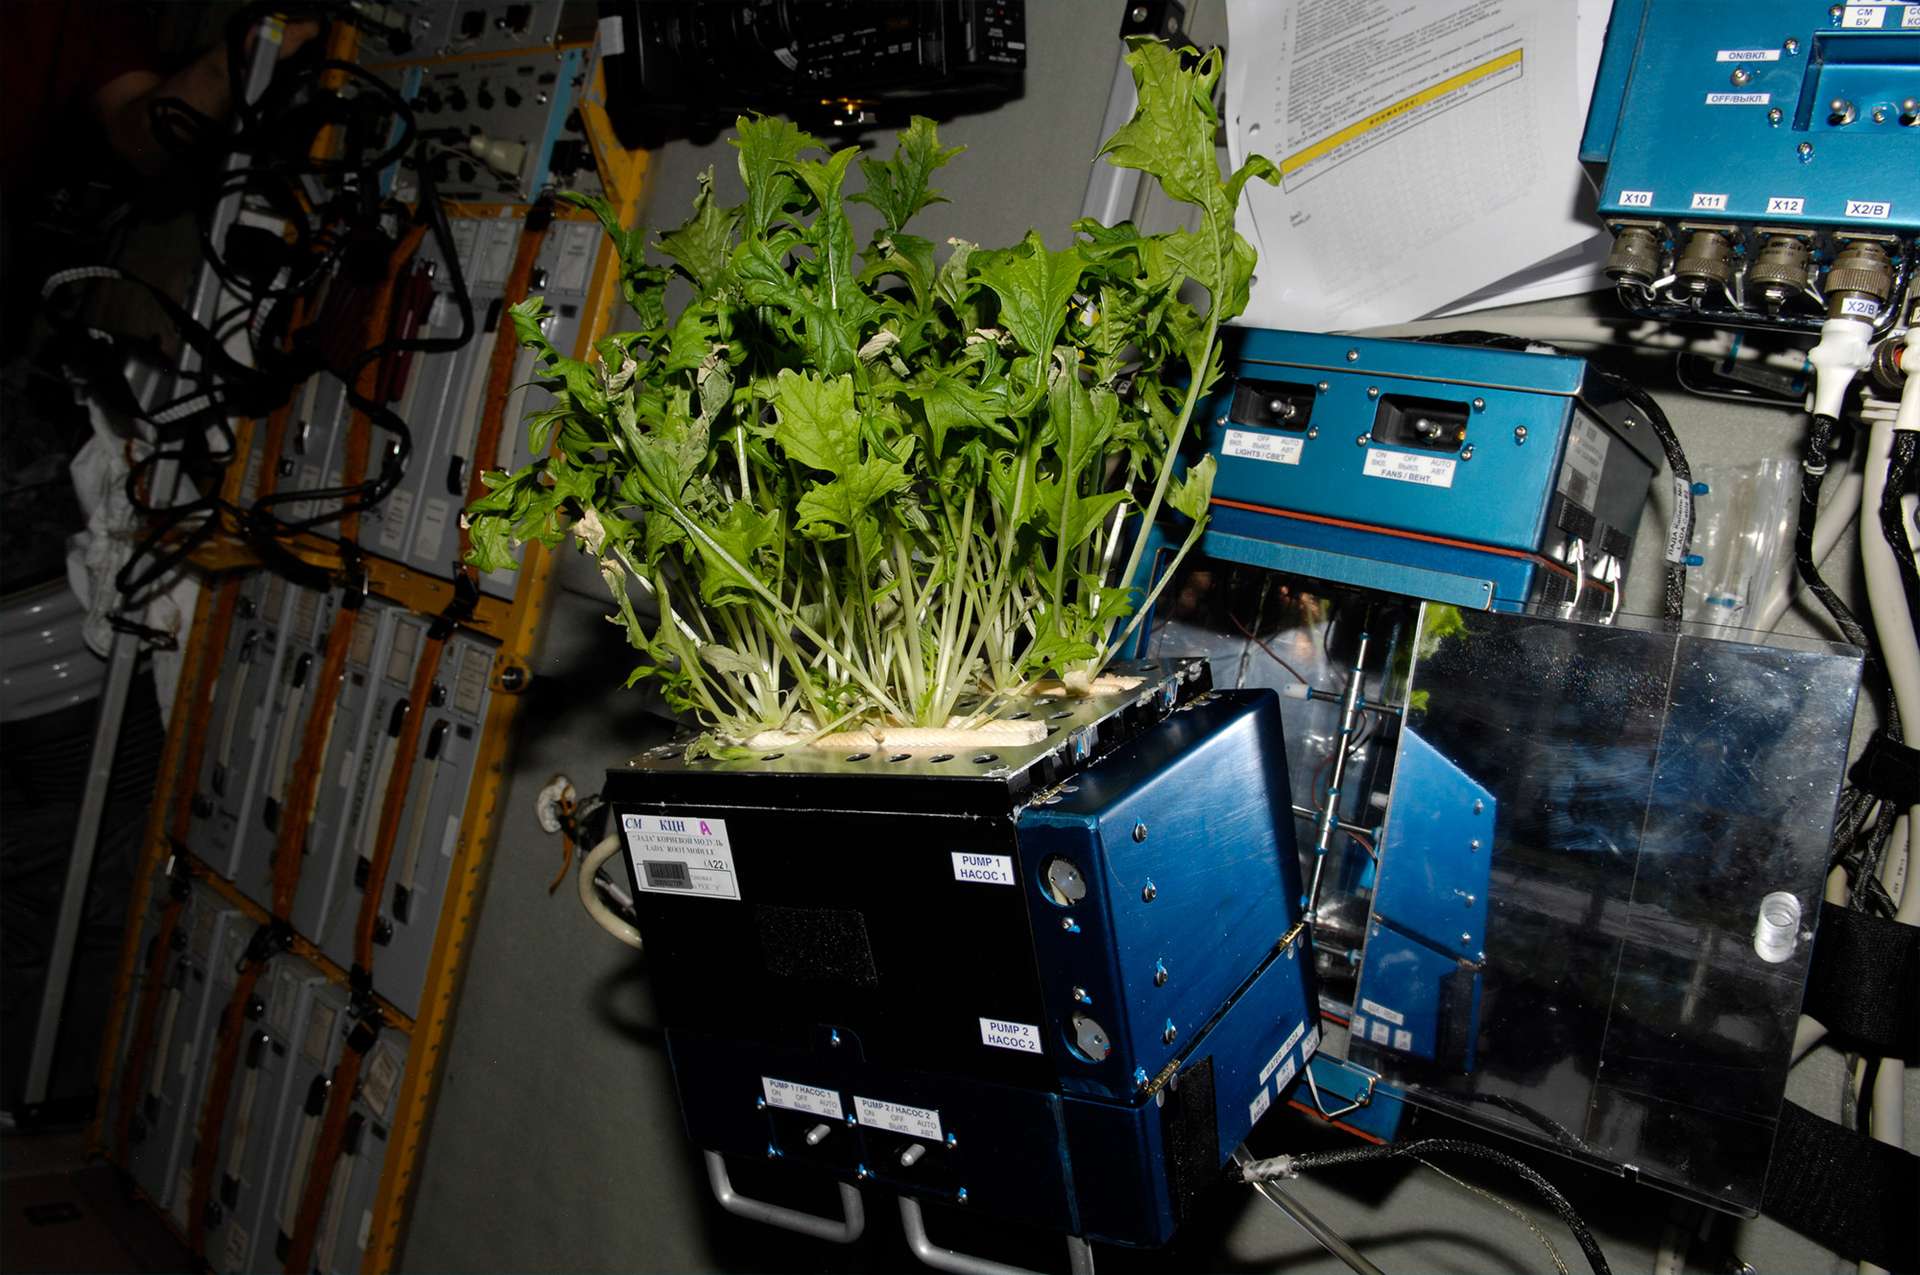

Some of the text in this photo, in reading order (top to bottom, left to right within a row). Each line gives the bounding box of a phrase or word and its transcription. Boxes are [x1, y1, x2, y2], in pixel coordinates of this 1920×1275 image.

[1624, 193, 1648, 204] X10
[1697, 197, 1721, 207] X11
[1772, 200, 1799, 211] X12
[1380, 468, 1403, 479] FANS
[962, 855, 1001, 868] PUMP 1
[1002, 872, 1007, 882] 1
[990, 1022, 1030, 1037] PUMP 2
[1028, 1040, 1036, 1050] 2
[862, 1099, 884, 1110] PUMP
